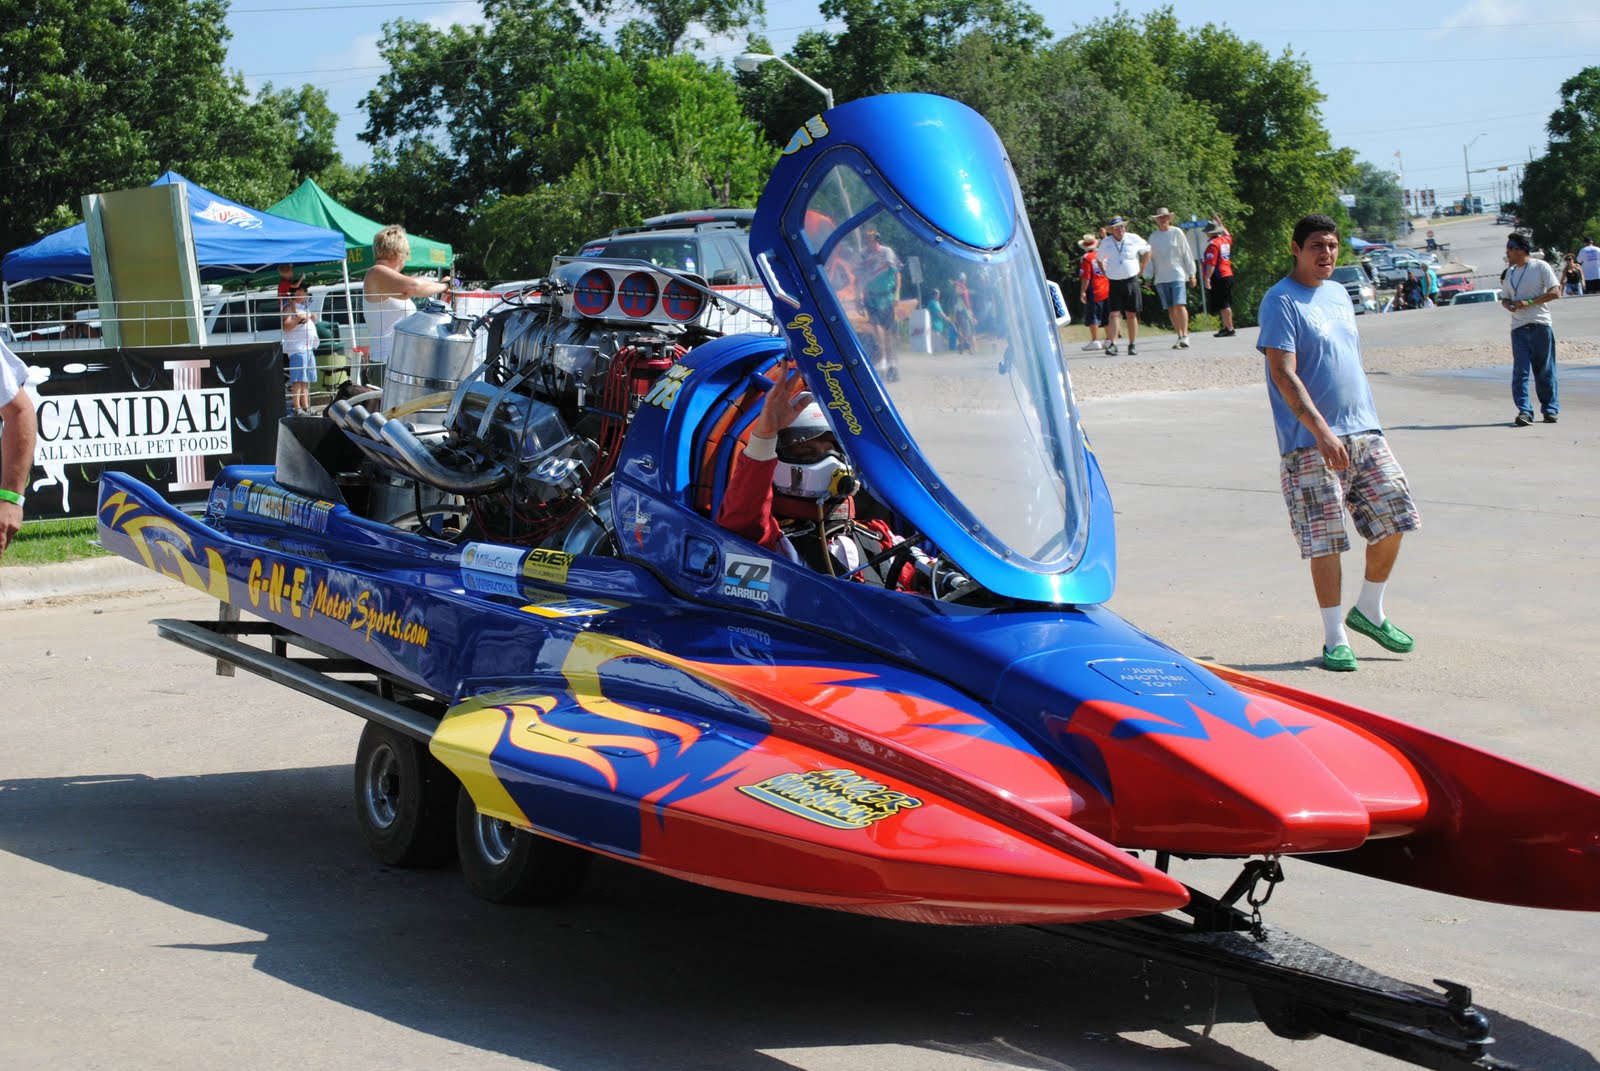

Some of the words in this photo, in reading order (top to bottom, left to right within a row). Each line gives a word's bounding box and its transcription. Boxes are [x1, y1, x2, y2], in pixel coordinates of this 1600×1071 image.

[37, 391, 227, 442] CANIDAE
[38, 446, 69, 460] ALL
[73, 440, 142, 459] NATURAL
[147, 438, 175, 454] PET
[179, 435, 229, 451] FOODS
[528, 549, 565, 566] BME
[724, 585, 769, 602] CARRILLO
